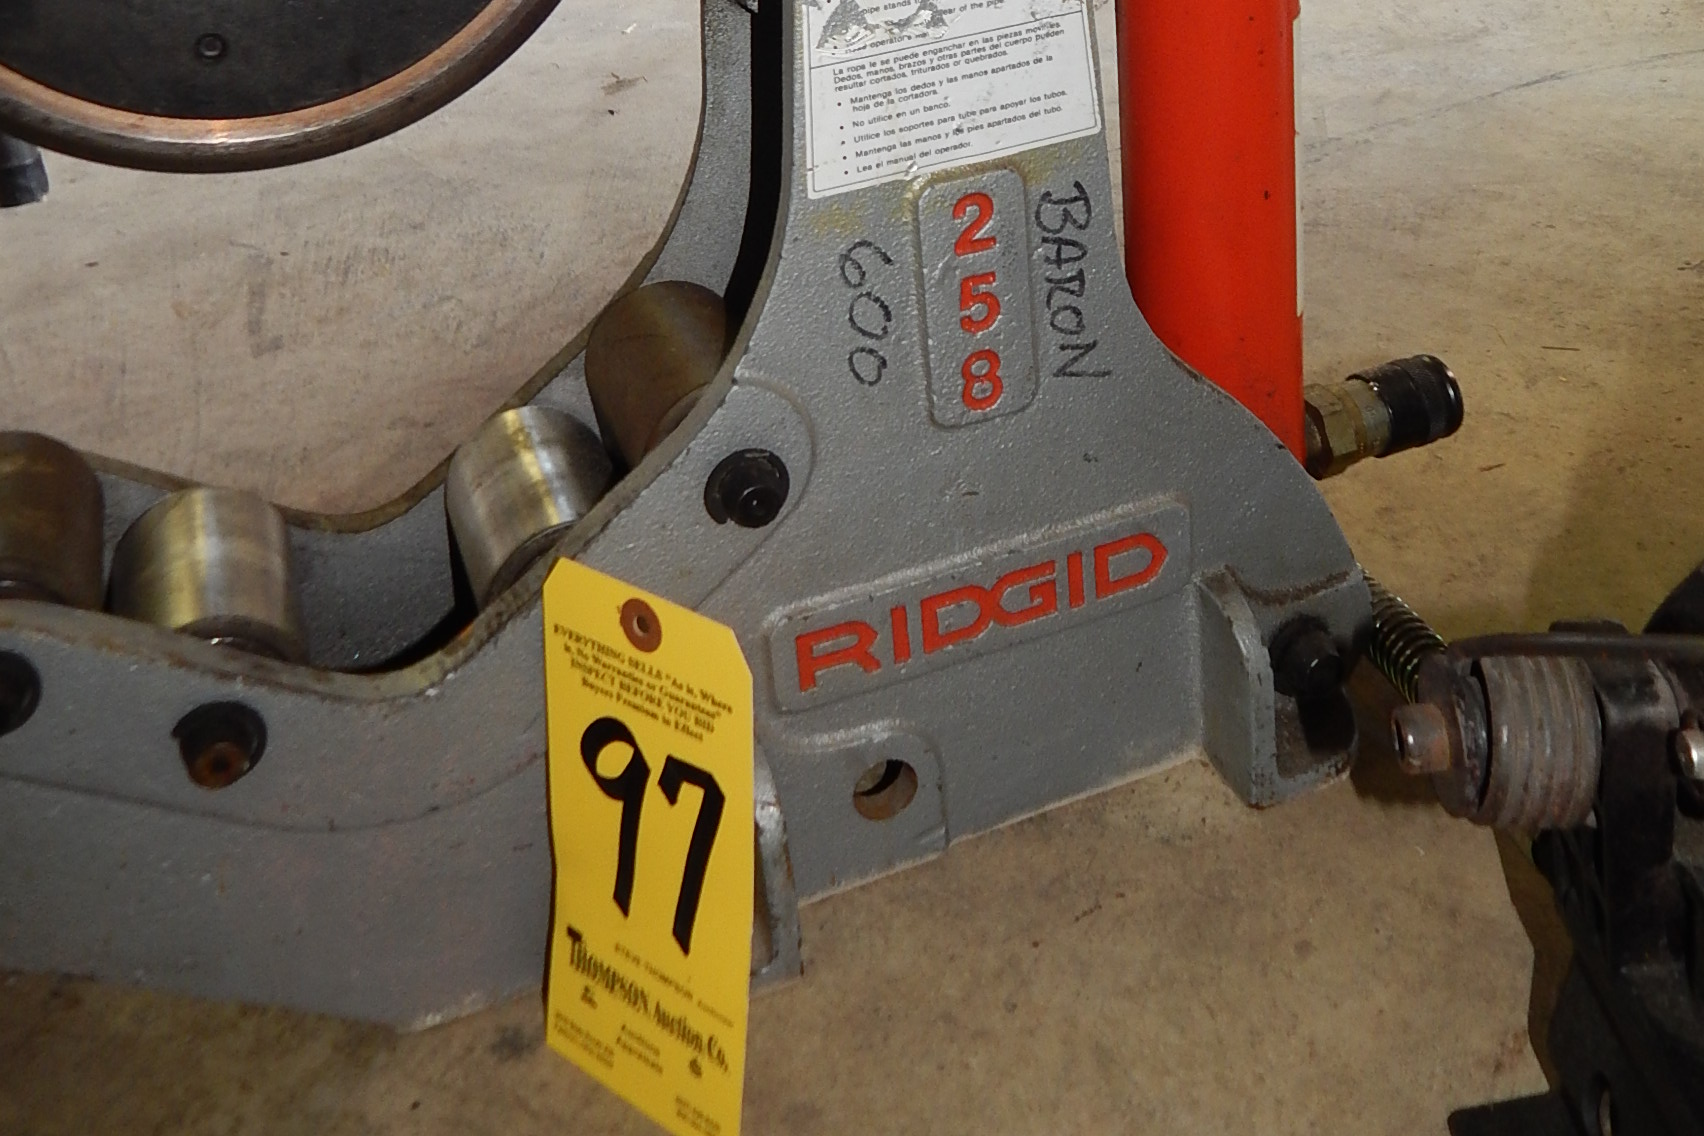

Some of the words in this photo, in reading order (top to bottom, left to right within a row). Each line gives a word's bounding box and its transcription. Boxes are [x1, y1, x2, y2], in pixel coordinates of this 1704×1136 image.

[860, 6, 881, 16] pipe
[959, 2, 967, 12] of
[970, 2, 983, 10] the
[833, 67, 844, 76] La
[847, 64, 866, 74] ropa
[893, 52, 919, 64] puede
[922, 42, 965, 57] enganchar
[982, 36, 993, 44] las
[996, 30, 1022, 42] piezas
[898, 59, 926, 70] brazos
[937, 52, 957, 61] otras
[961, 46, 986, 58] partes
[990, 43, 1001, 51] del
[1004, 36, 1032, 48] cuerpo
[835, 80, 866, 92] resultar
[911, 62, 950, 75] triturados
[850, 90, 892, 104] Mantenga
[895, 87, 907, 95] los
[911, 80, 935, 92] dedos
[939, 79, 944, 87] y
[946, 75, 958, 83] las
[961, 70, 988, 80] manos
[991, 60, 1030, 74] apartados
[1033, 57, 1043, 65] de
[852, 104, 870, 113] hoja
[852, 120, 864, 128] No
[868, 114, 892, 125] utilice
[923, 102, 950, 112] banco.
[854, 132, 880, 143] Utilice
[884, 128, 895, 136] los
[899, 120, 934, 133] soportes
[937, 116, 955, 126] para
[979, 106, 997, 116] para
[1000, 99, 1026, 111] apoyar
[1030, 95, 1041, 103] los
[1044, 90, 1067, 100] tubos.
[855, 144, 896, 158] Mantenga
[900, 140, 912, 148] las
[915, 133, 941, 144] manos
[967, 123, 984, 133] pies
[987, 115, 1026, 128] apartados
[1029, 110, 1041, 118] del
[857, 165, 872, 173] Lea
[887, 153, 916, 165] manual
[919, 150, 931, 158] del
[1035, 180, 1112, 378] BARON
[839, 239, 894, 386] 600
[795, 532, 1169, 692] RIDGID
[619, 680, 662, 708] BEFORE
[667, 700, 690, 722] YOU
[580, 716, 726, 956] 97
[567, 925, 650, 1016] THOMPSON
[653, 1000, 703, 1054] Auction
